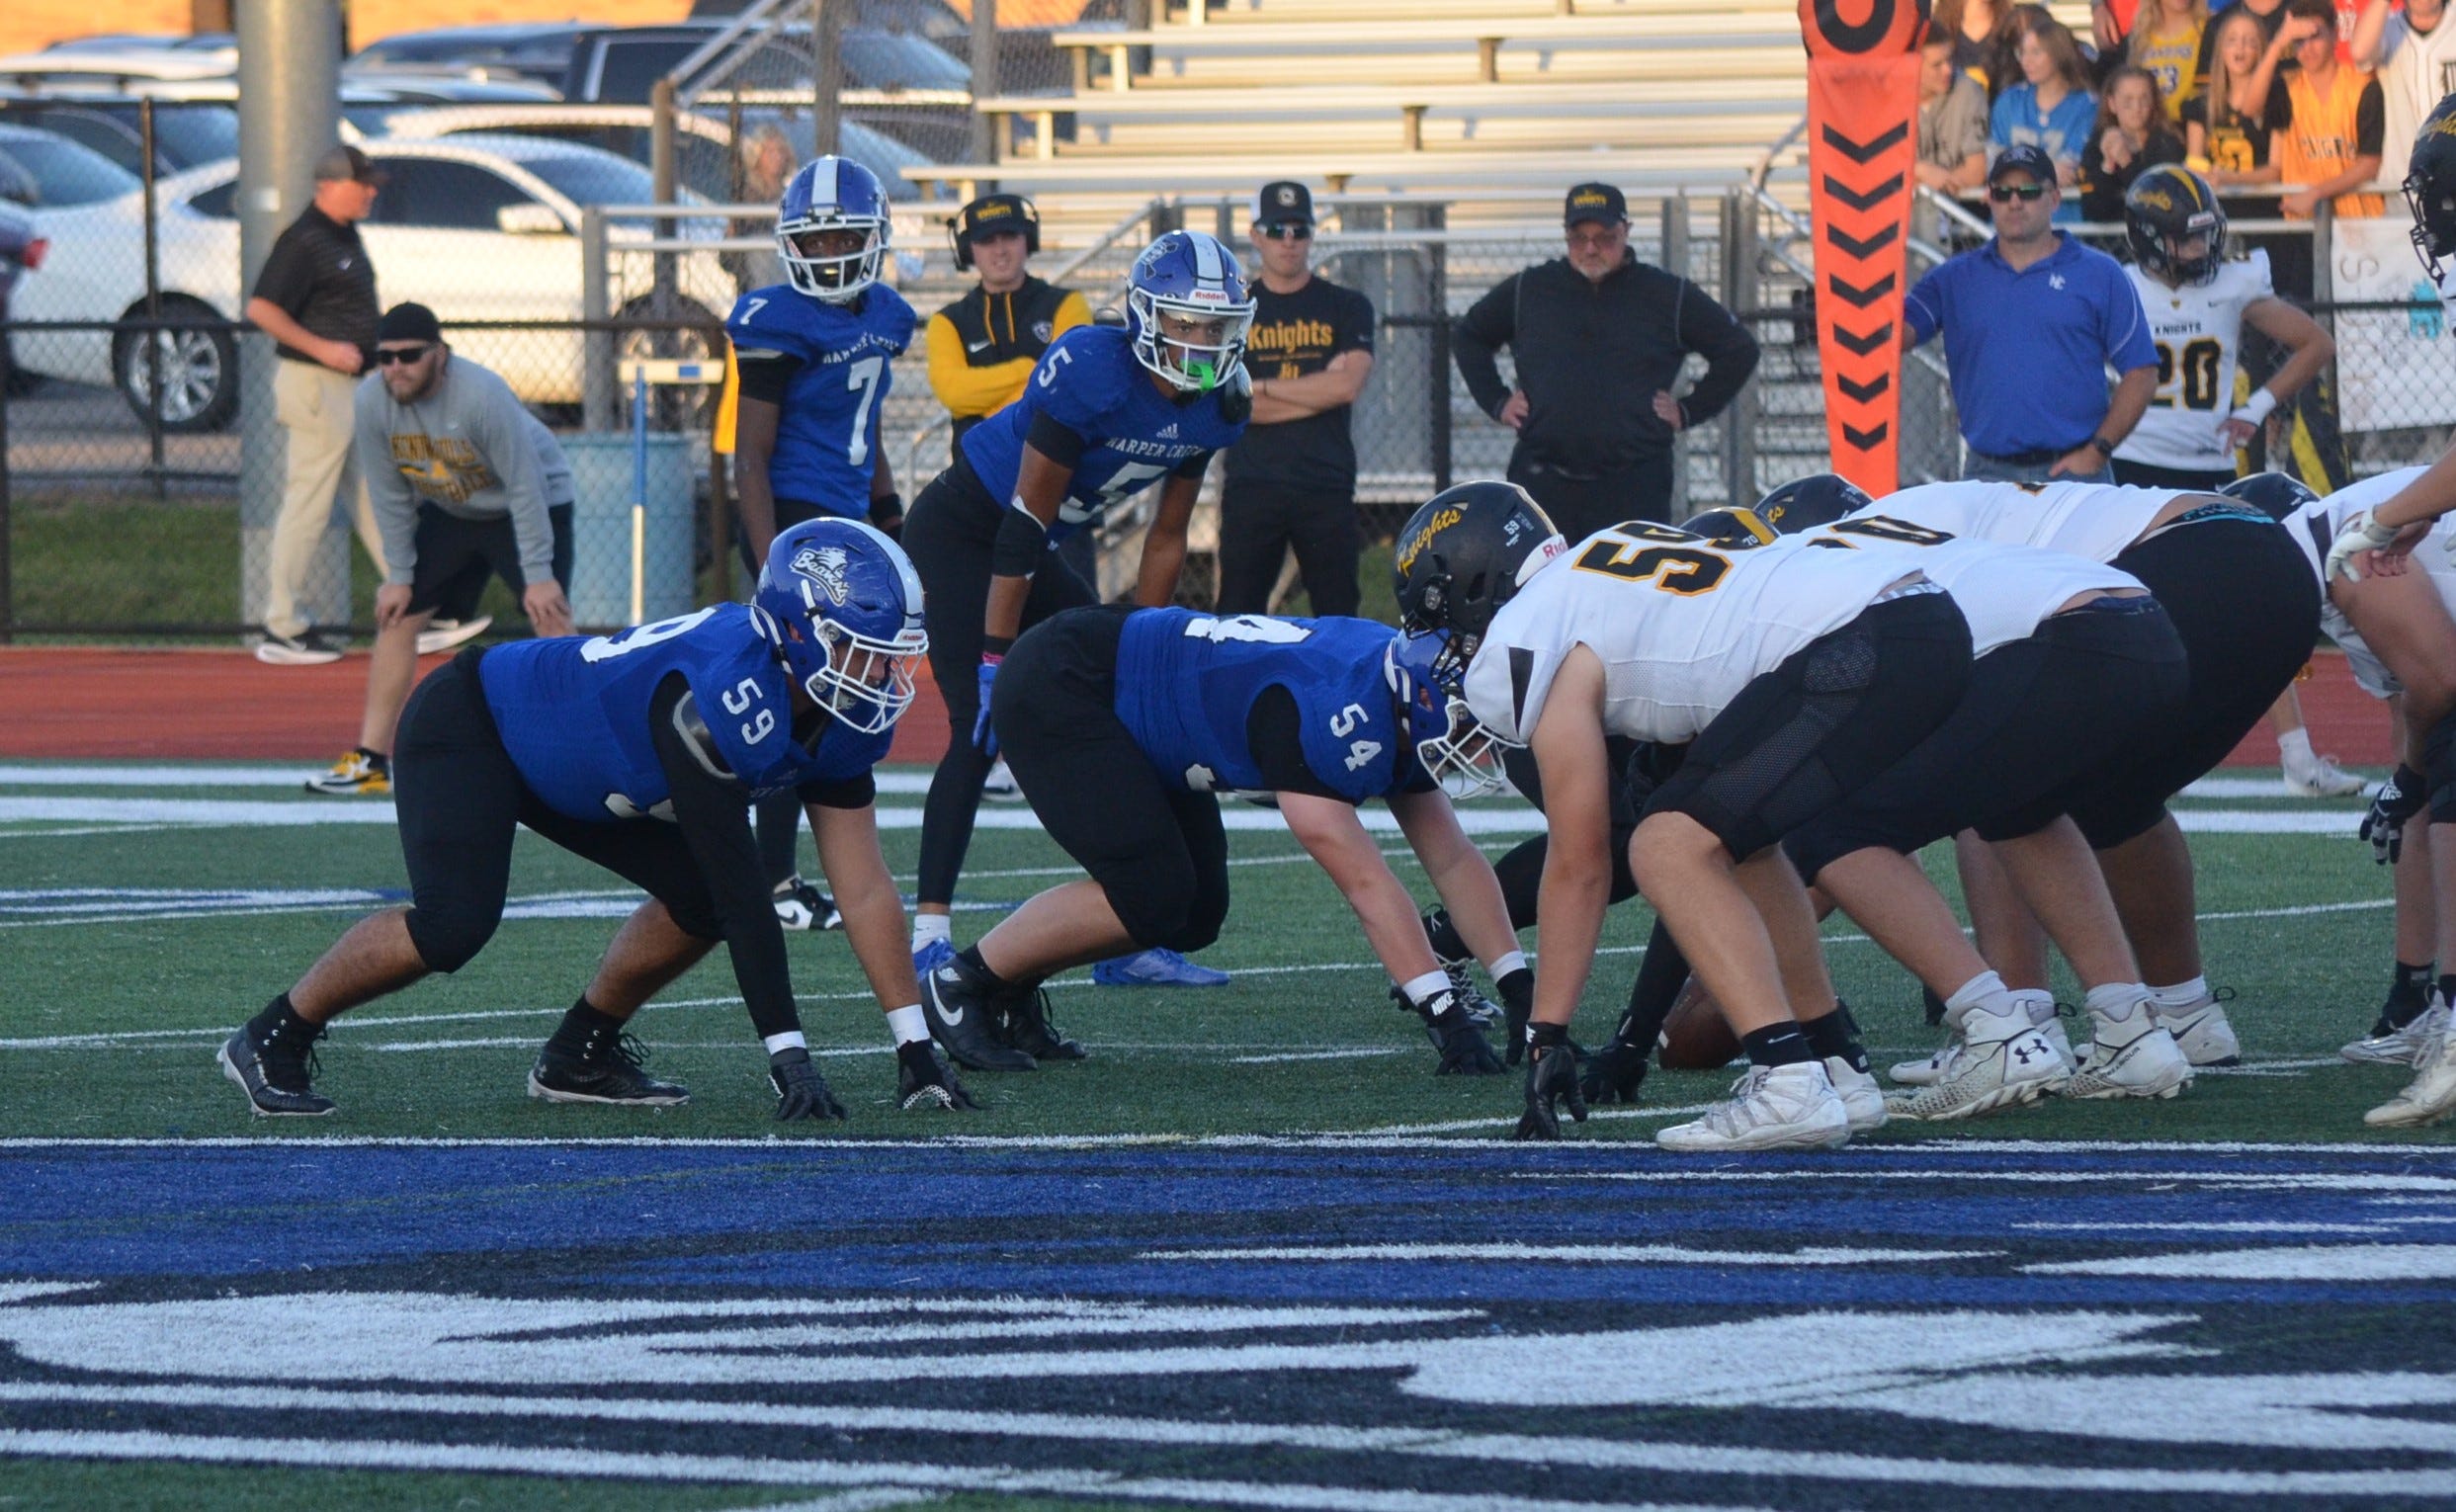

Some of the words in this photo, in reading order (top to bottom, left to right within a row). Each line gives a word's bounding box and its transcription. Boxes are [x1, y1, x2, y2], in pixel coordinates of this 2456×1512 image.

[739, 298, 768, 325] 7
[1195, 292, 1227, 300] Riddell
[1247, 318, 1333, 354] Knights
[2156, 322, 2202, 334] KNIGHTS
[1039, 346, 1073, 387] 5
[2156, 337, 2222, 411] 20
[848, 357, 883, 466] 7
[1397, 508, 1462, 578] Knights
[1742, 535, 1759, 546] 70
[722, 677, 775, 745] 59
[1330, 703, 1383, 772] 54
[1430, 990, 1456, 1017] NIKE
